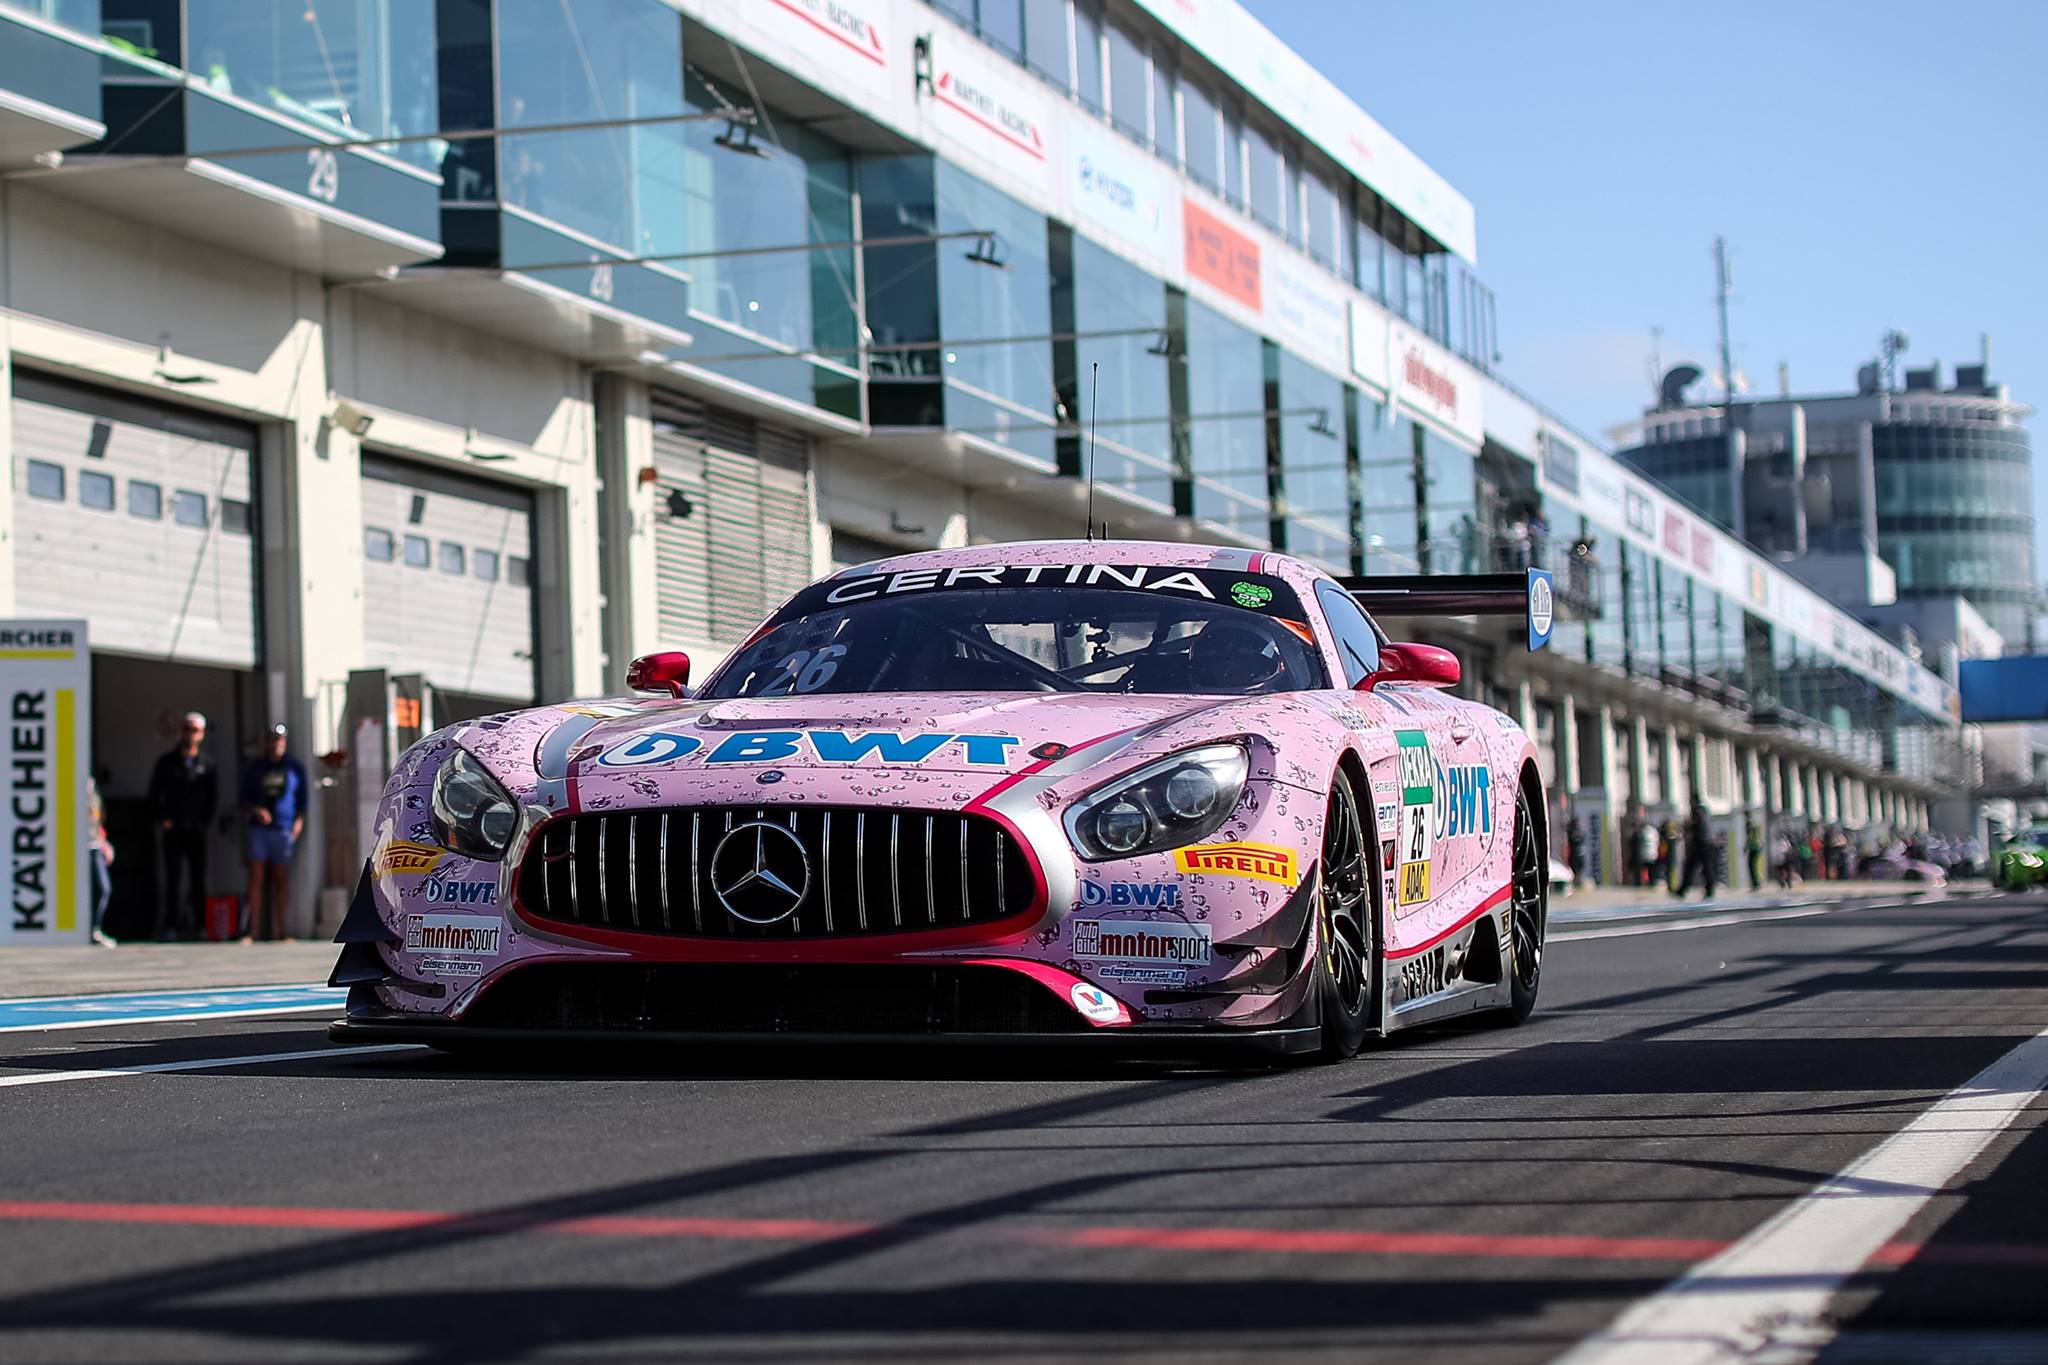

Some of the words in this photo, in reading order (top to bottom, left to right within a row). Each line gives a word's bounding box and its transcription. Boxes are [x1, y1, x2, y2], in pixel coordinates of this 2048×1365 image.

[308, 148, 337, 201] 29
[827, 564, 1215, 604] CERTINA
[0, 629, 74, 648] RCHER
[757, 644, 848, 697] 26
[703, 730, 1021, 766] BWT
[1400, 745, 1433, 788] DEKRA
[13, 689, 46, 931] KÄRCHER
[1448, 765, 1491, 837] BWT
[1410, 806, 1425, 860] 26
[1184, 847, 1289, 879] PIRELLI
[443, 880, 496, 904] BWT
[1110, 883, 1179, 907] BWT
[1405, 863, 1426, 901] ADAC
[421, 924, 500, 954] motorsport
[1076, 922, 1098, 938] Auto
[1076, 938, 1098, 954] Bild
[1100, 931, 1211, 963] motorsport
[422, 960, 482, 971] eisenmann
[1100, 967, 1186, 979] eisenmann
